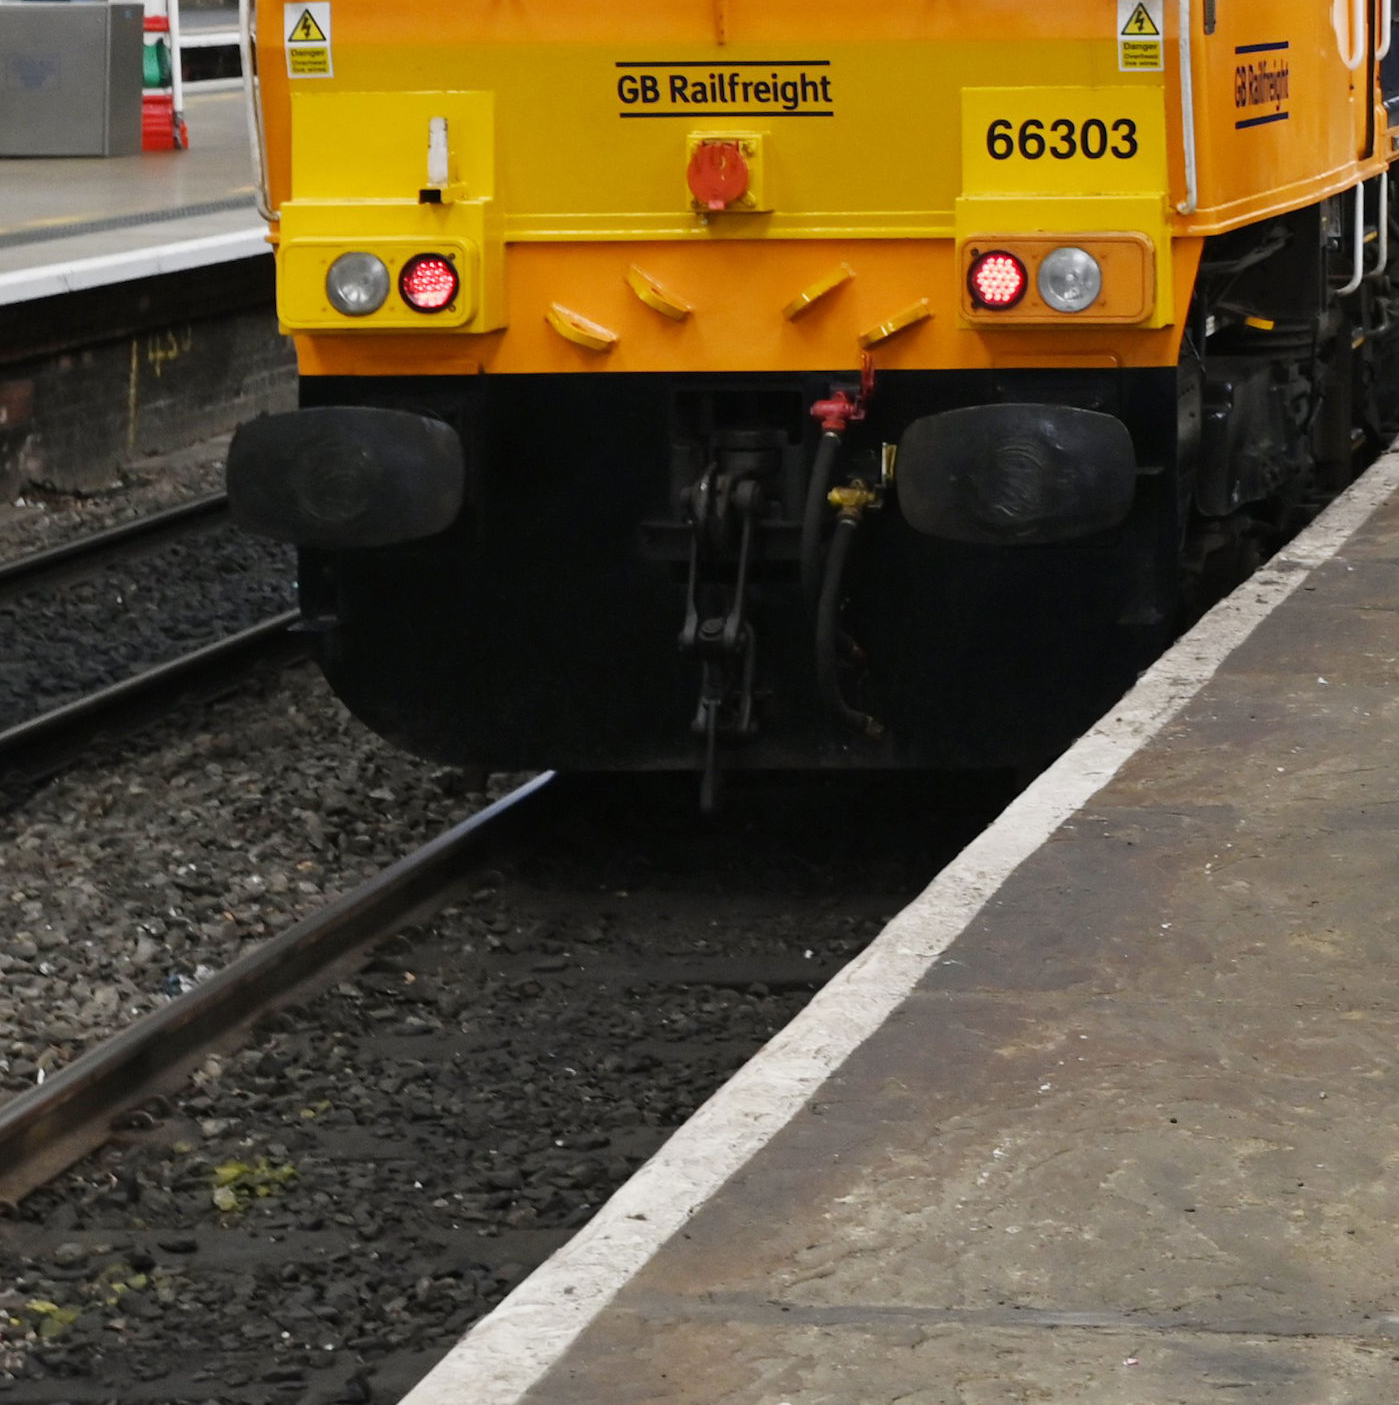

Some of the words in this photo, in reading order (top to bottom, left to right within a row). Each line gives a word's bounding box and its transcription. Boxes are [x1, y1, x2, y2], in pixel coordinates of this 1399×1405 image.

[290, 48, 325, 58] Danger
[1123, 42, 1157, 52] Danger
[617, 74, 661, 104] GB
[668, 72, 833, 110] Railfreight
[1235, 65, 1247, 108] GB
[1248, 58, 1289, 111] Railfreight
[986, 118, 1139, 161] 66303
